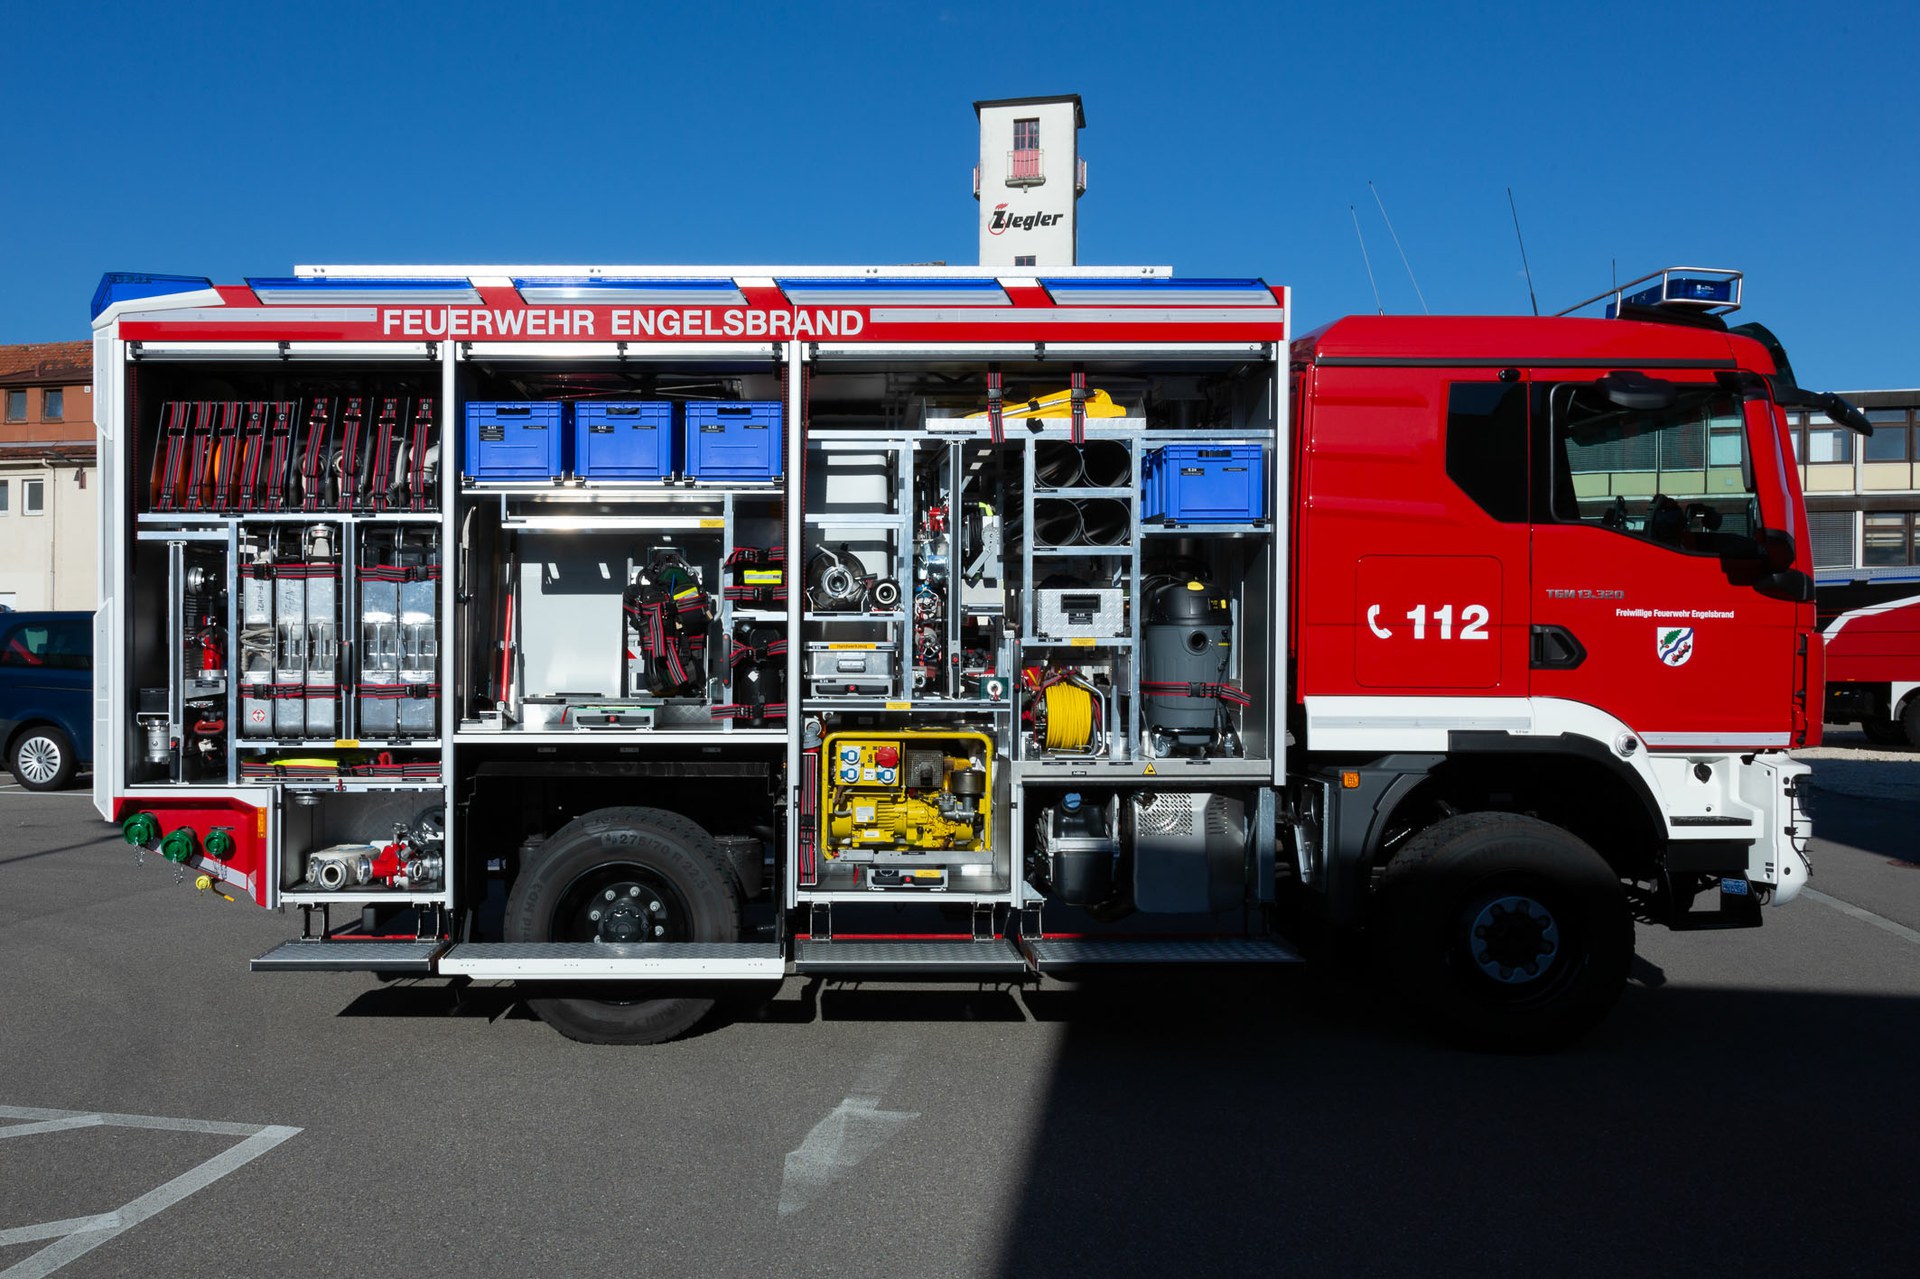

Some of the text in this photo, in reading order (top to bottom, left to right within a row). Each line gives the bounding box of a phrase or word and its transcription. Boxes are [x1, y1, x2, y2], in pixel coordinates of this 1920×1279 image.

[383, 309, 864, 336] FEUERWEHR ENGELSBRAND
[1546, 589, 1625, 600] TGM 13.320
[1406, 604, 1489, 640] 112
[1616, 608, 1735, 619] Freiwillige Feuerwehr Engelsbrand
